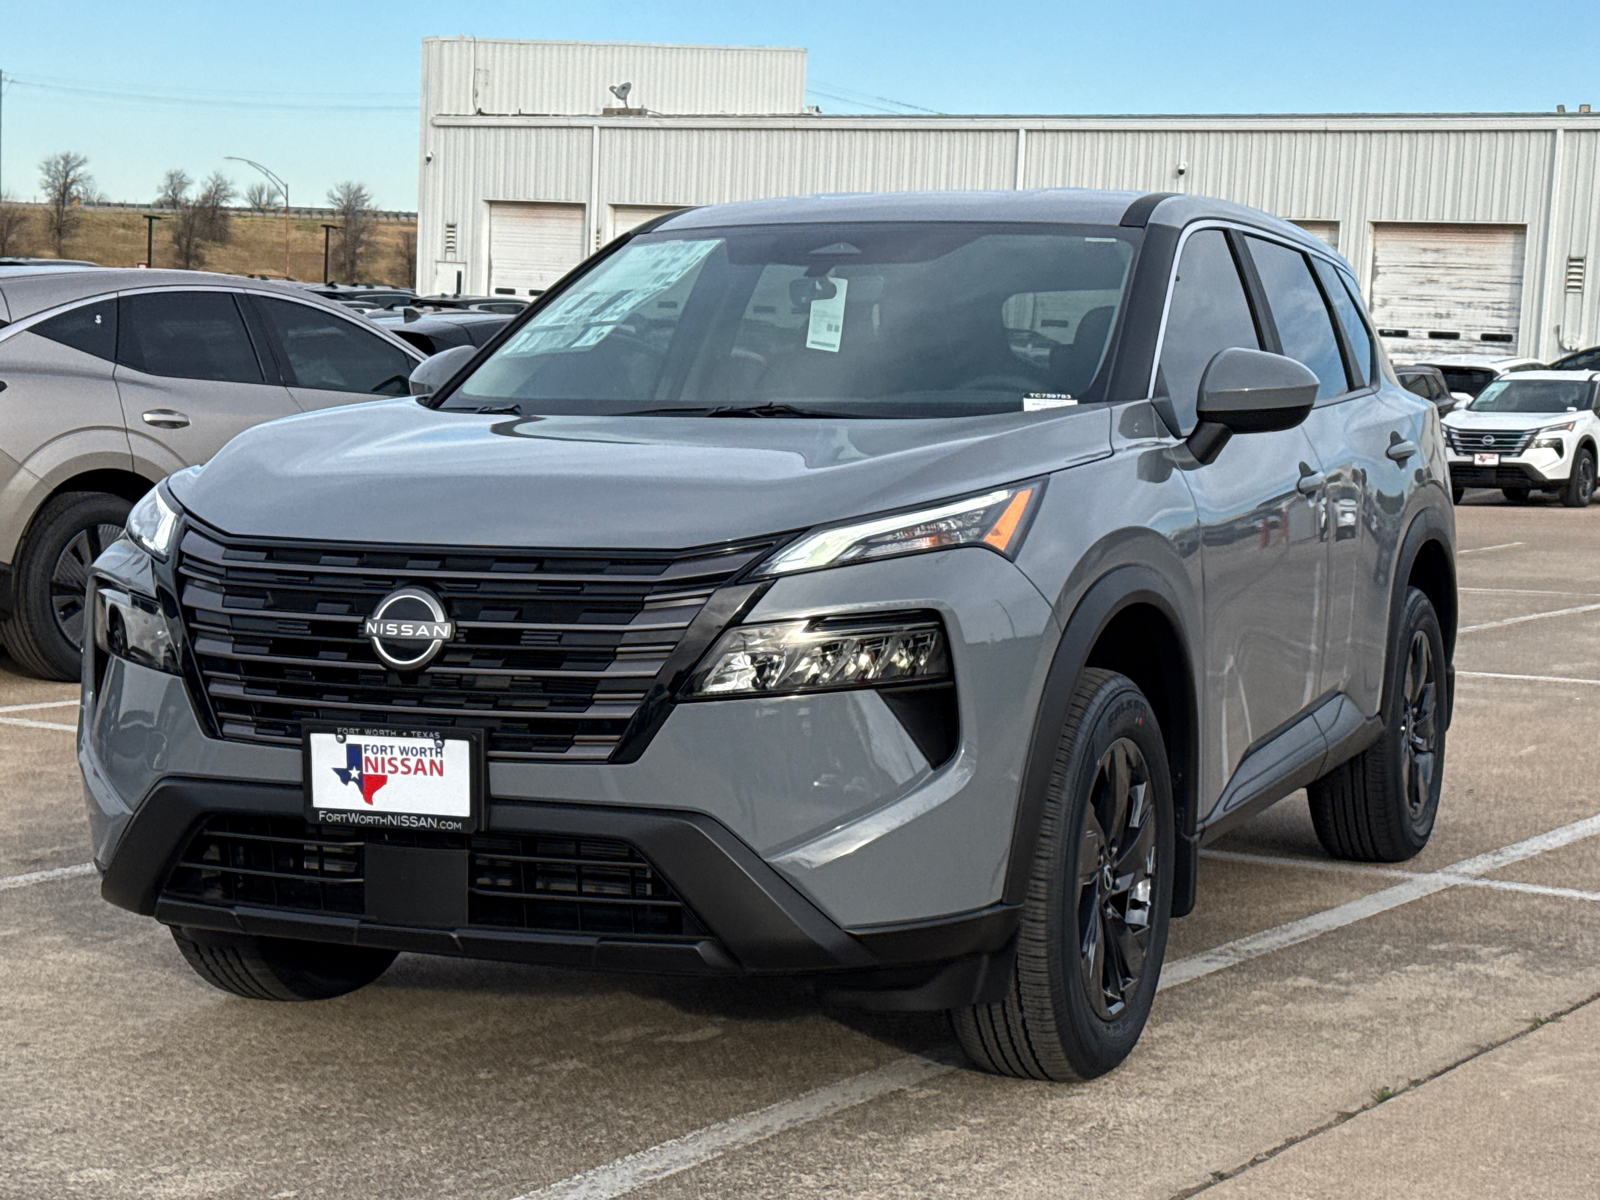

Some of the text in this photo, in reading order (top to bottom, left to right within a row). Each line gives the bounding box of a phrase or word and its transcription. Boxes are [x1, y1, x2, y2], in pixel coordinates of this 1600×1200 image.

[366, 621, 449, 637] NISSAN
[336, 727, 441, 739] FORT WORTH TEXAS
[363, 744, 443, 758] FORT WORTH
[364, 755, 444, 777] NISSAN
